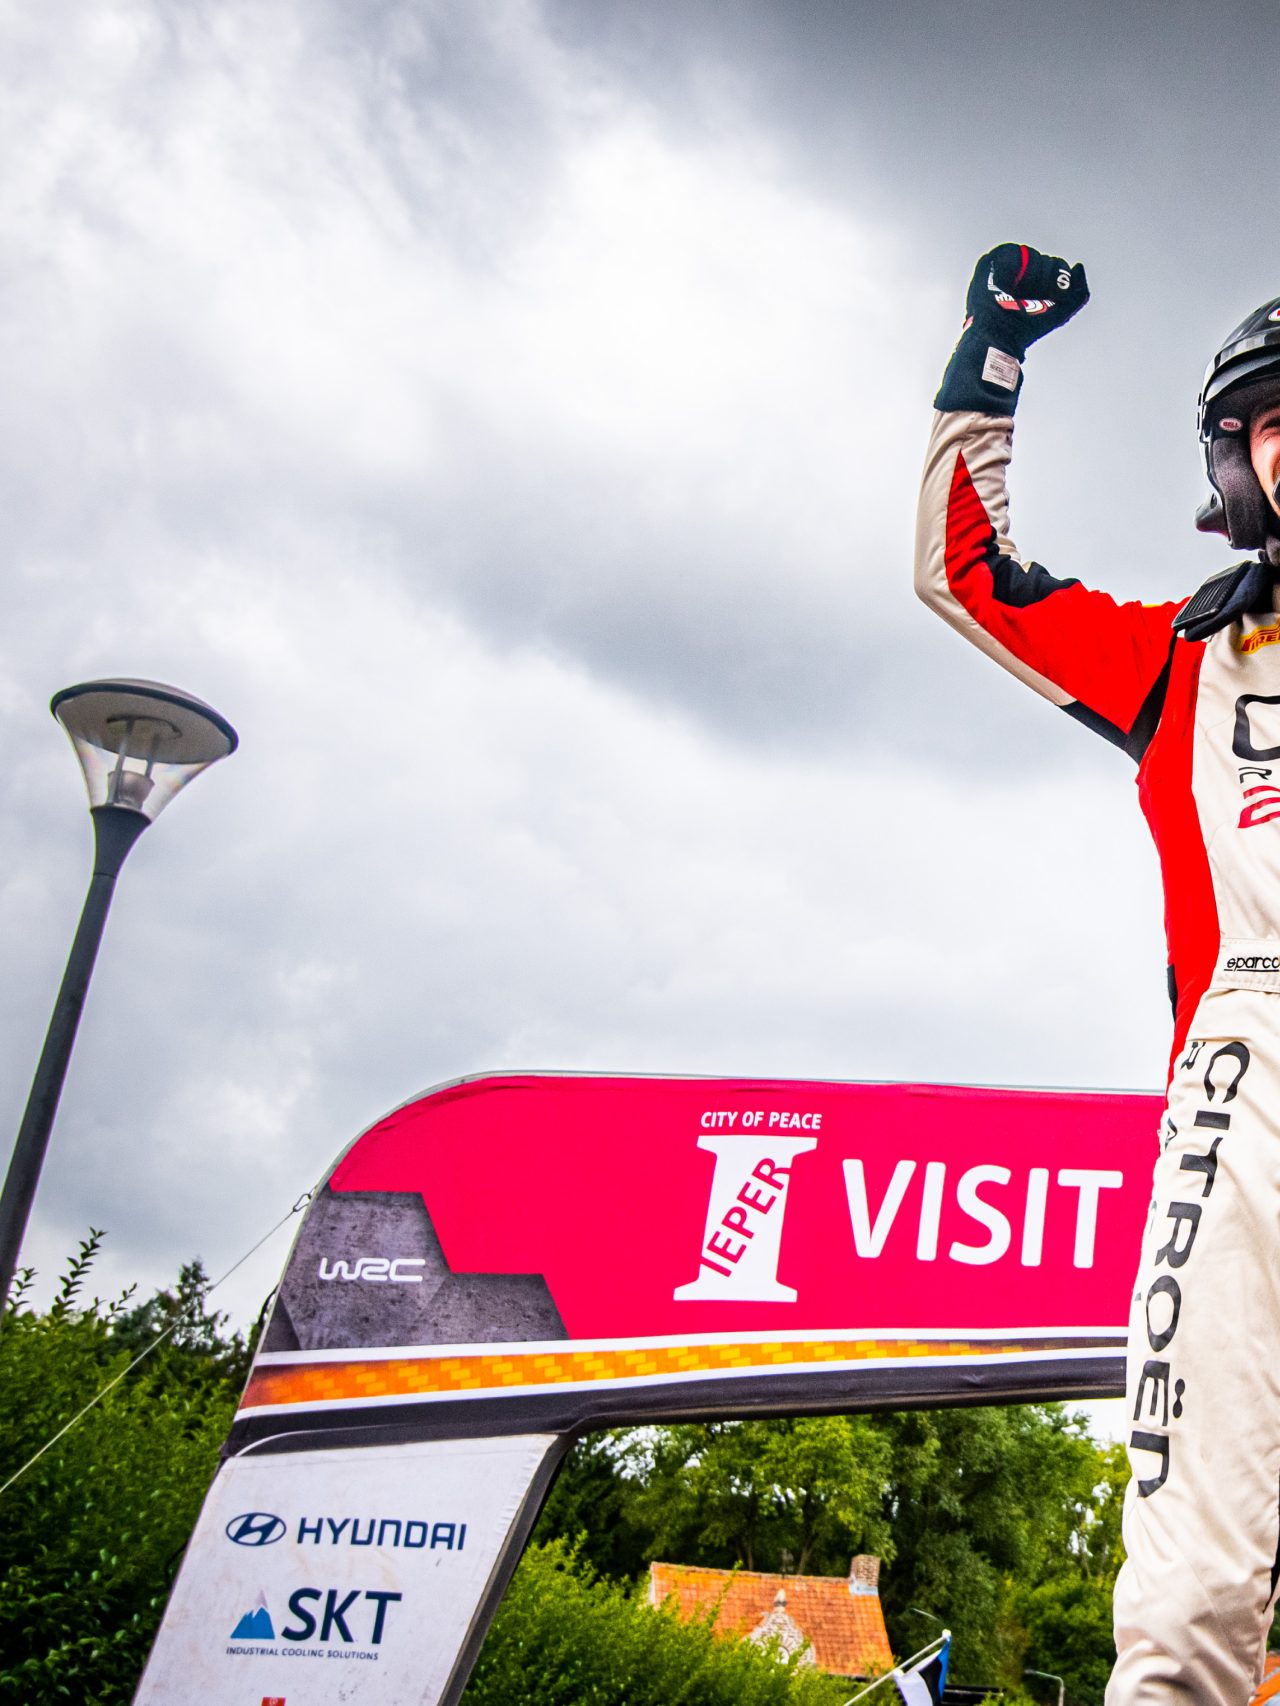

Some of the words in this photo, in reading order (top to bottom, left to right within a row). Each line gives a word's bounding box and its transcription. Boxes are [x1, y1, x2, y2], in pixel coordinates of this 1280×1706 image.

[700, 1111, 738, 1129] CITY
[742, 1111, 764, 1129] OF
[768, 1111, 822, 1130] PEACE
[700, 1156, 792, 1278] IEPER
[842, 1158, 1124, 1269] VISIT
[318, 1257, 426, 1283] WRC
[297, 1516, 467, 1551] HYUNDAI
[281, 1587, 403, 1646] SKT
[226, 1647, 278, 1656] INDUSTRIAL
[281, 1648, 324, 1658] COOLING
[327, 1650, 379, 1661] SOLUTIONS
